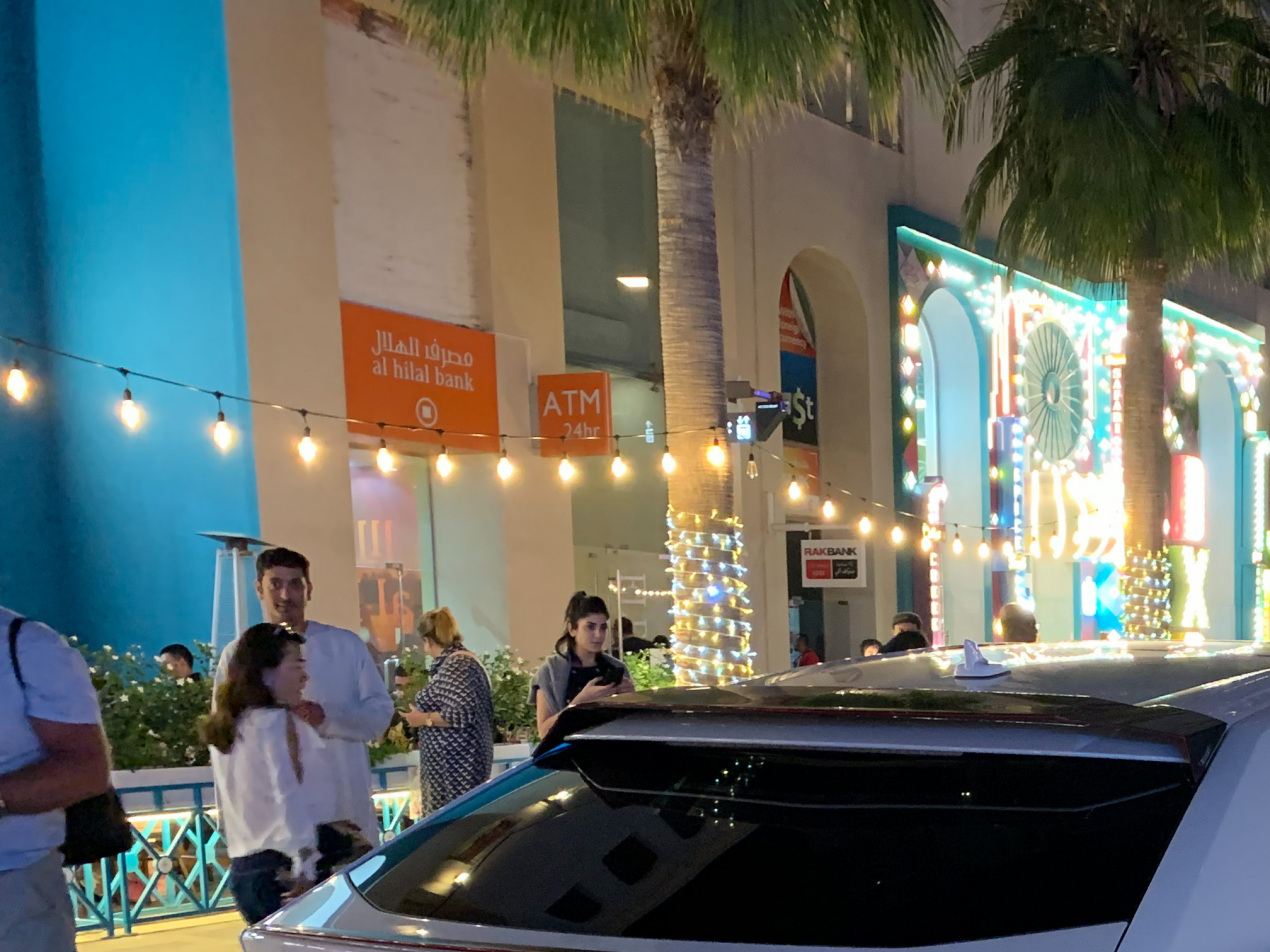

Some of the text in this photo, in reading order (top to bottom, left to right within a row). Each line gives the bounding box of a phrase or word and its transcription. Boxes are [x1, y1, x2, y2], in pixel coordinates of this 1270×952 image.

[373, 358, 475, 392] al hilal bank
[543, 389, 601, 416] ATM
[563, 423, 601, 439] 24hr
[804, 547, 857, 556] RAKBANK
